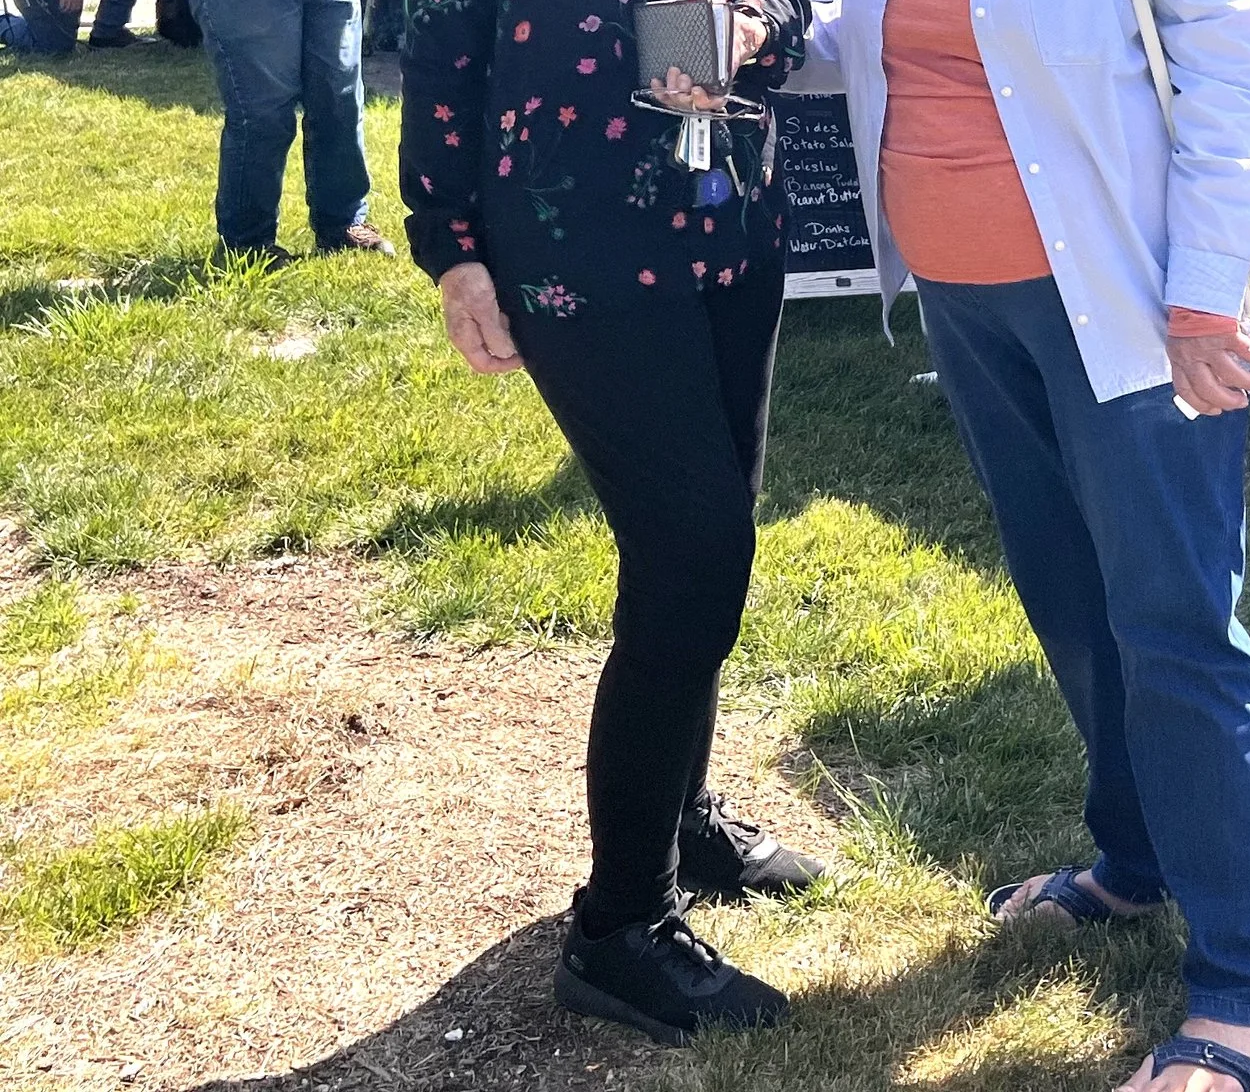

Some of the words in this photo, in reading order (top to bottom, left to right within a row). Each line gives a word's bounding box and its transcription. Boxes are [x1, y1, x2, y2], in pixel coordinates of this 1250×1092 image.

[786, 116, 839, 134] Sides
[780, 136, 826, 150] Potato
[788, 192, 825, 205] Peanut
[804, 222, 850, 235] Drinks
